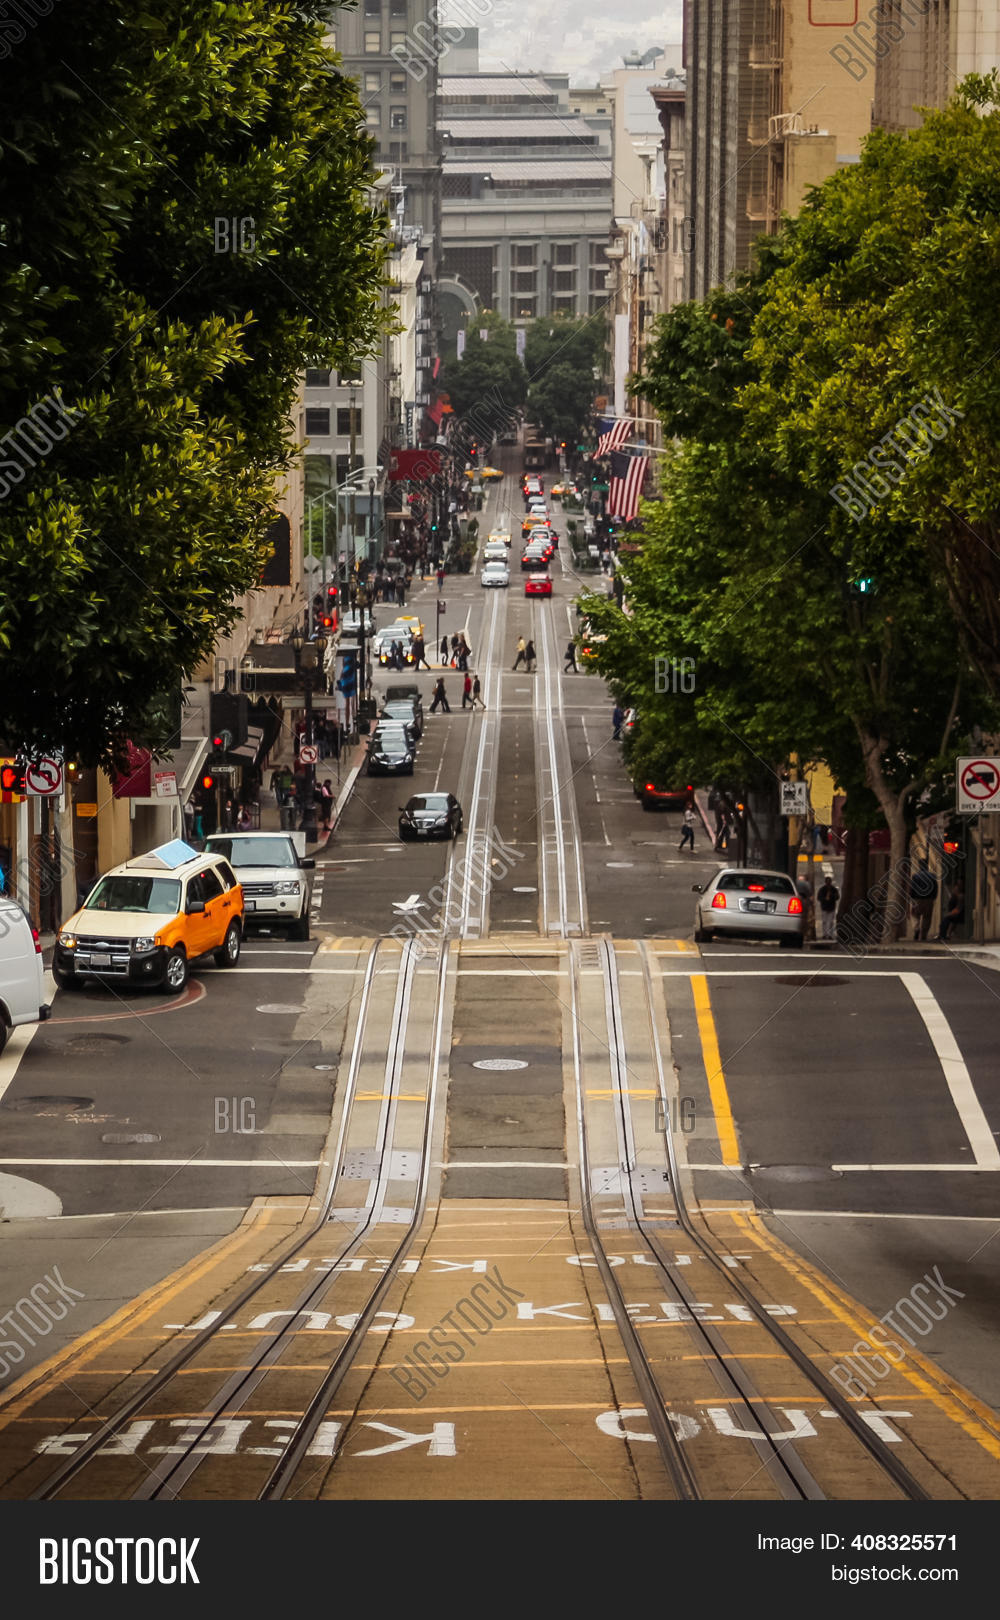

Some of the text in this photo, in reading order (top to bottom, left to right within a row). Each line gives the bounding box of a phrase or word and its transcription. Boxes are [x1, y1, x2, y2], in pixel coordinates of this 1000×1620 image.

[565, 1254, 752, 1267] OUT
[516, 1302, 798, 1322] KEEP
[595, 1408, 913, 1442] OUT
